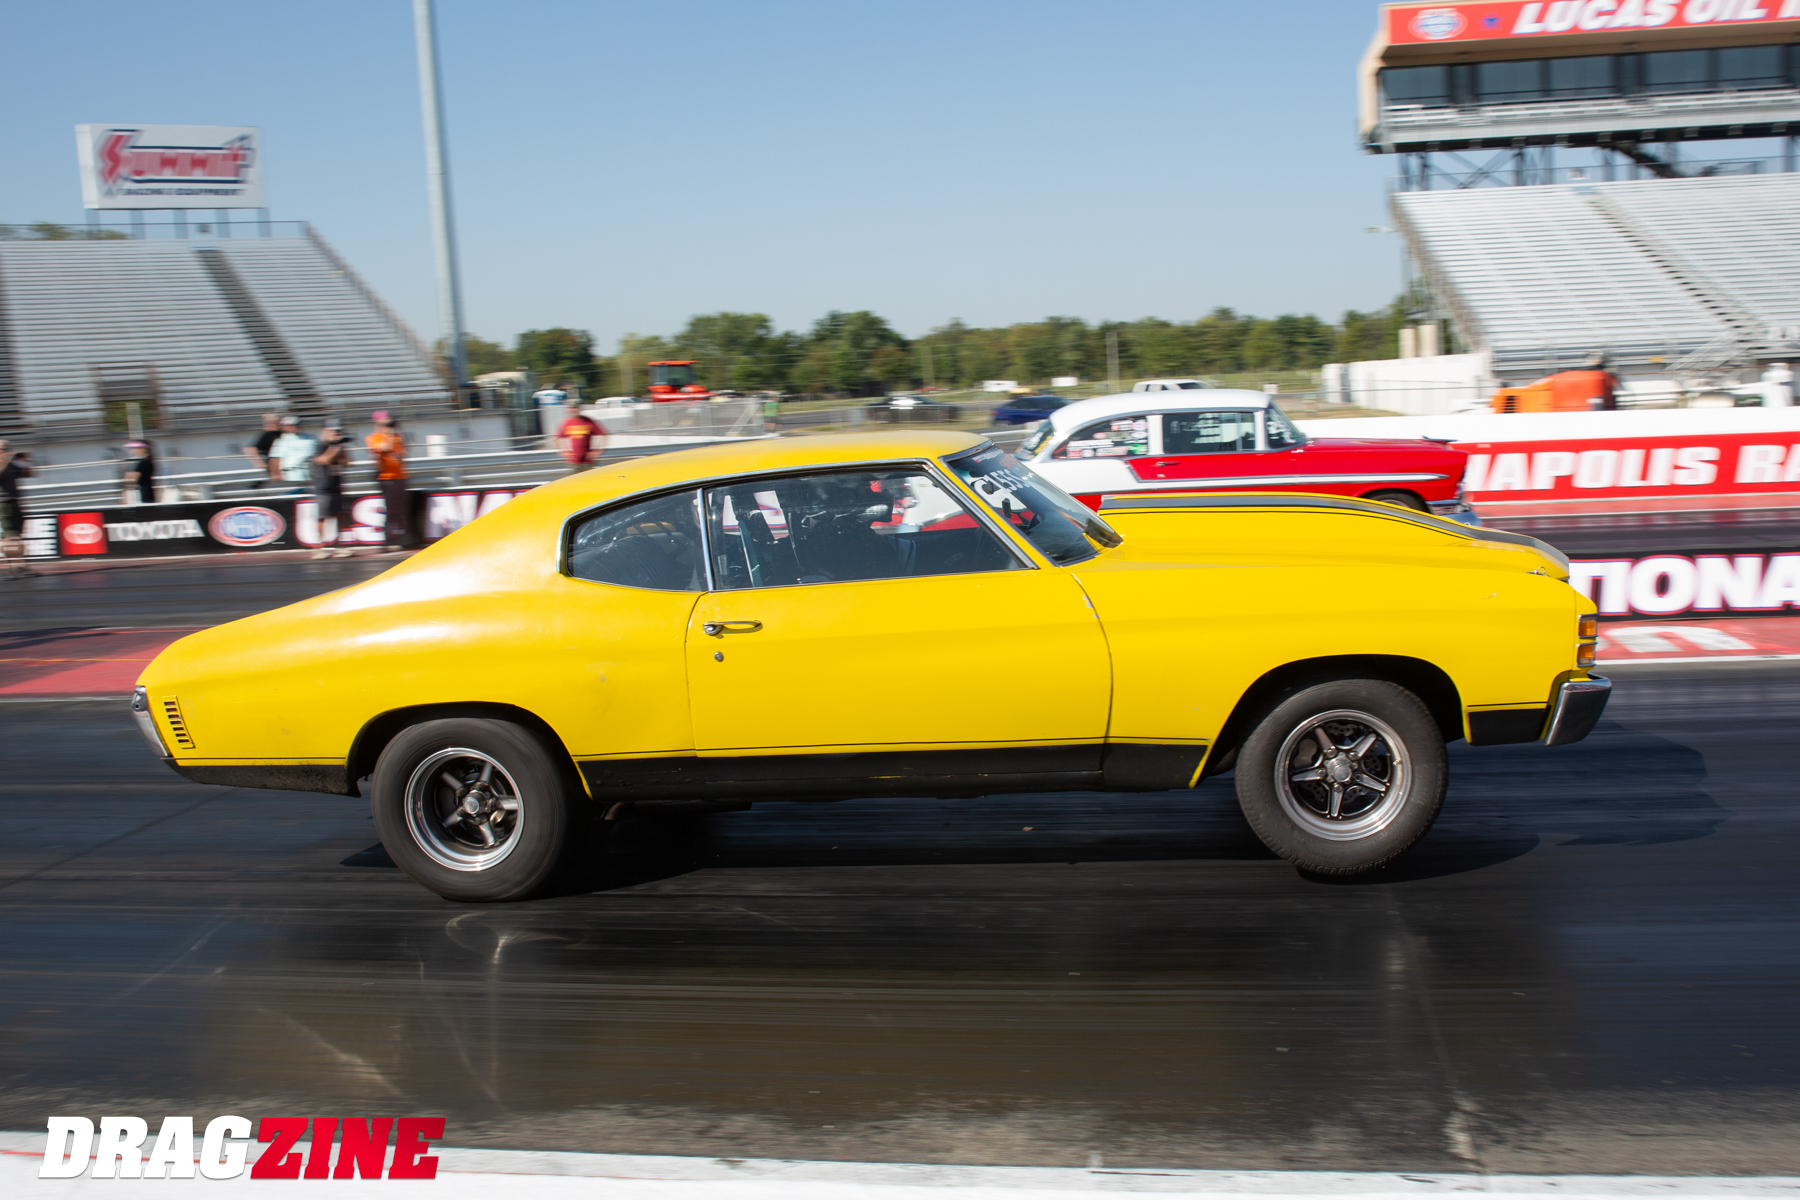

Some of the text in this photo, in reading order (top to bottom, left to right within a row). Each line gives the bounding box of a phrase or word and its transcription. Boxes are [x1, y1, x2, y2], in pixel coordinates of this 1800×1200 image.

[1510, 0, 1682, 35] LUCAS
[1682, 0, 1769, 24] OIL
[103, 519, 206, 542] TOYOTA
